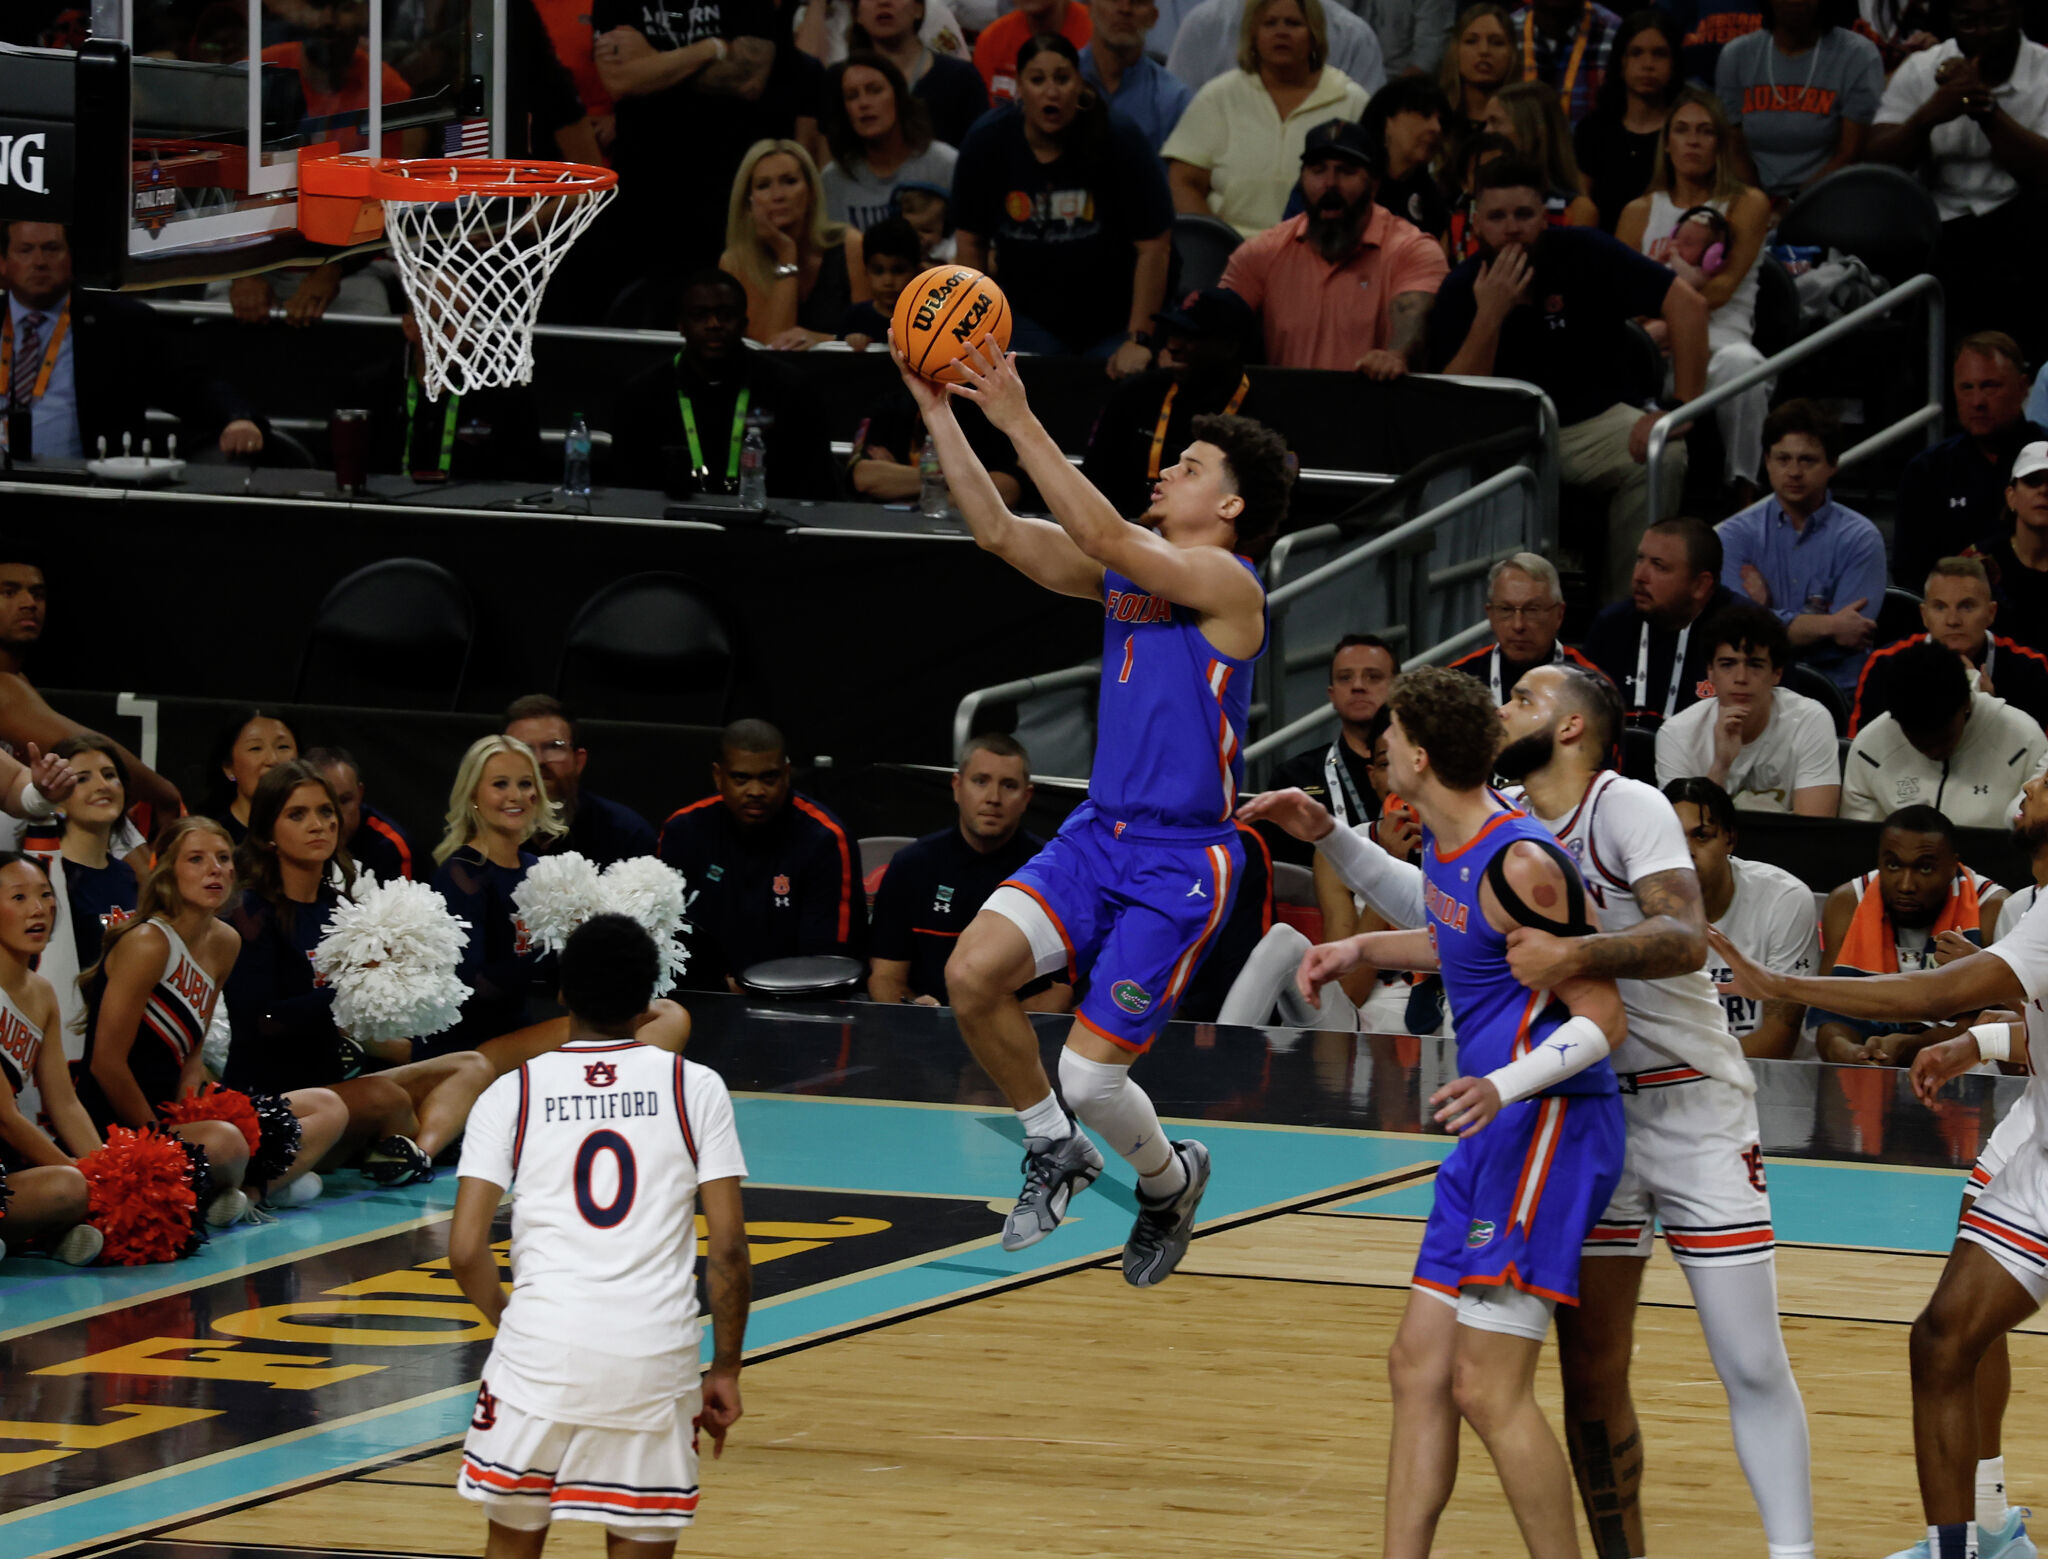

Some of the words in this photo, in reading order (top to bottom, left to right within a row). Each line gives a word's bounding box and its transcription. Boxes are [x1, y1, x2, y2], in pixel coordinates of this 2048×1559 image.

[1741, 84, 1837, 115] AUBURN
[912, 271, 973, 331] Wilson
[952, 293, 993, 344] NCAA
[545, 1091, 658, 1123] PETTIFORD
[573, 1128, 638, 1230] 0
